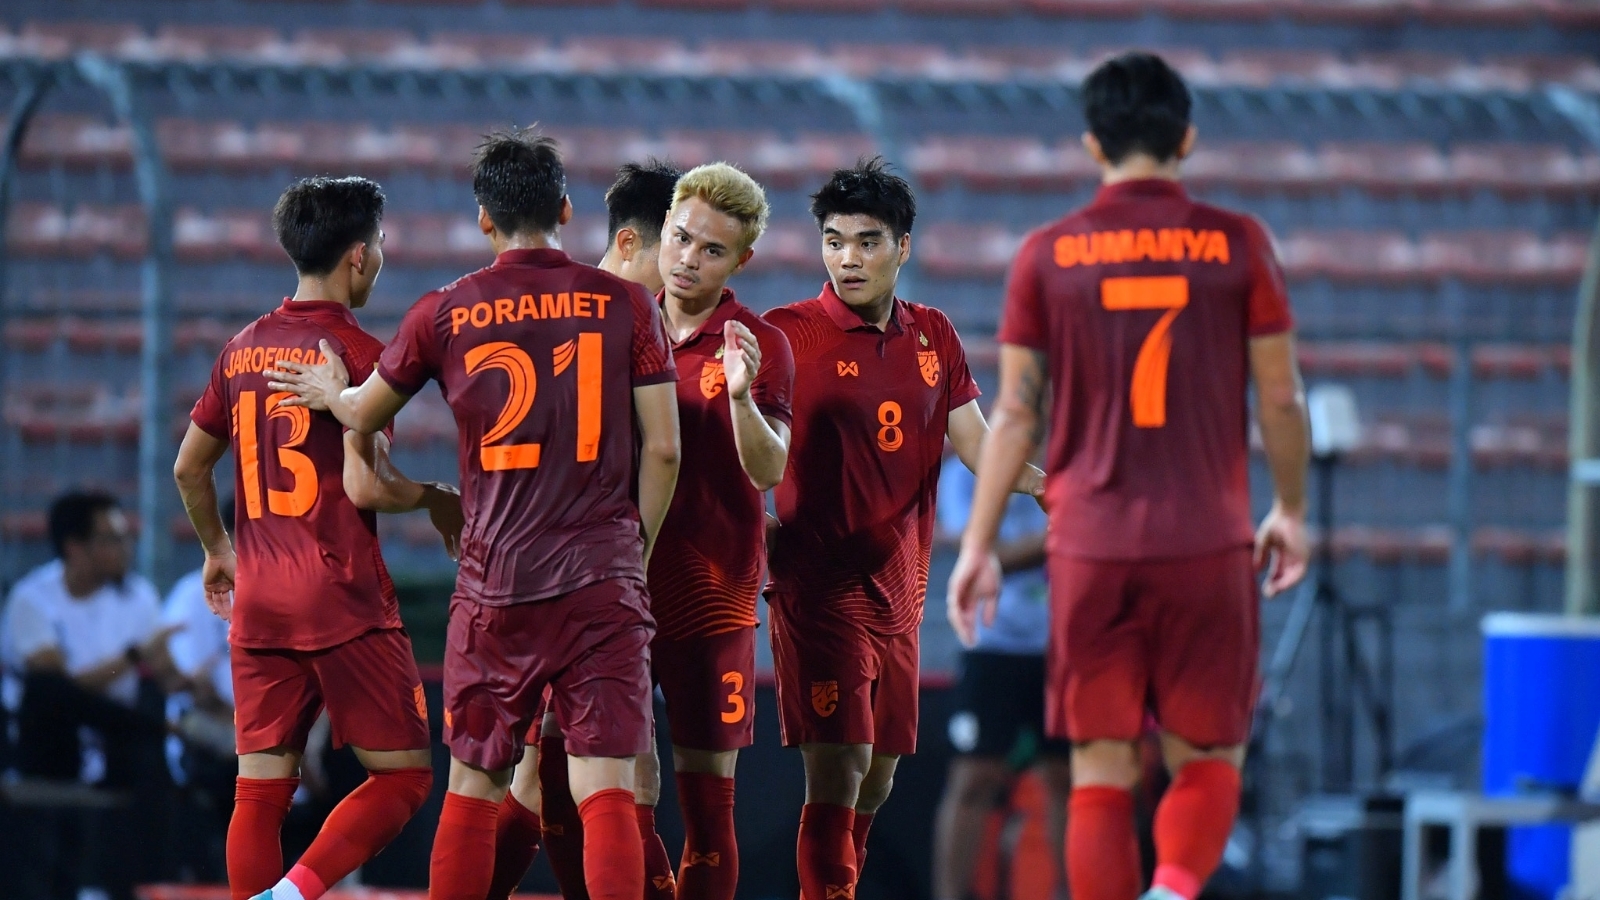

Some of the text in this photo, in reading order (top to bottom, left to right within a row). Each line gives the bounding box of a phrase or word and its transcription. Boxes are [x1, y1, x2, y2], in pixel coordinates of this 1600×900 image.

[1053, 230, 1229, 268] SUMANYA
[451, 292, 611, 335] PORAMET
[1101, 276, 1189, 428] 7
[464, 333, 602, 471] 21
[877, 401, 903, 452] 8
[232, 391, 318, 519] 13
[721, 671, 745, 724] 3
